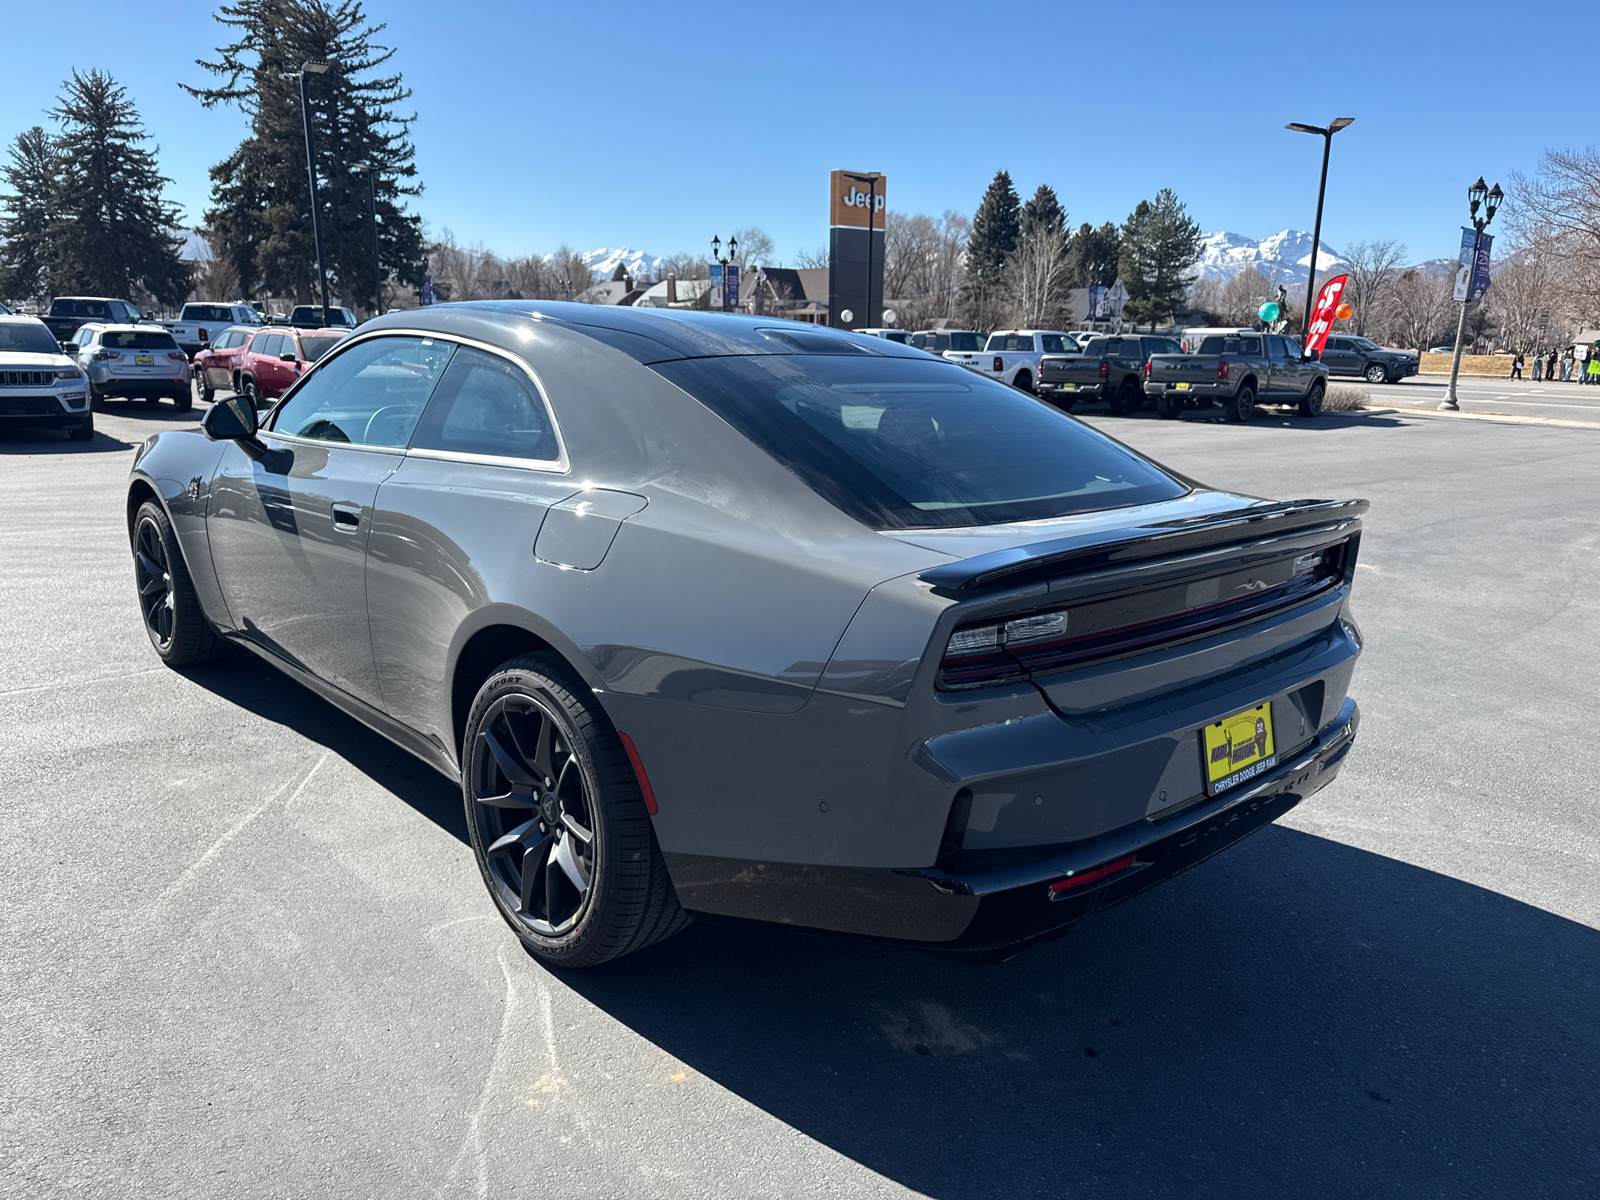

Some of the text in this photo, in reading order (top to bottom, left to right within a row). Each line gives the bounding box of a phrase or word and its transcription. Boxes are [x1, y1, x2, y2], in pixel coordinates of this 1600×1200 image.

[843, 186, 884, 213] Jeep
[487, 676, 523, 693] SPORT
[1256, 722, 1264, 734] 32
[1232, 741, 1257, 765] MALONE
[1214, 756, 1276, 793] CHRYSLER DODGE JEEP RAM
[541, 908, 599, 955] GOODYEAR
